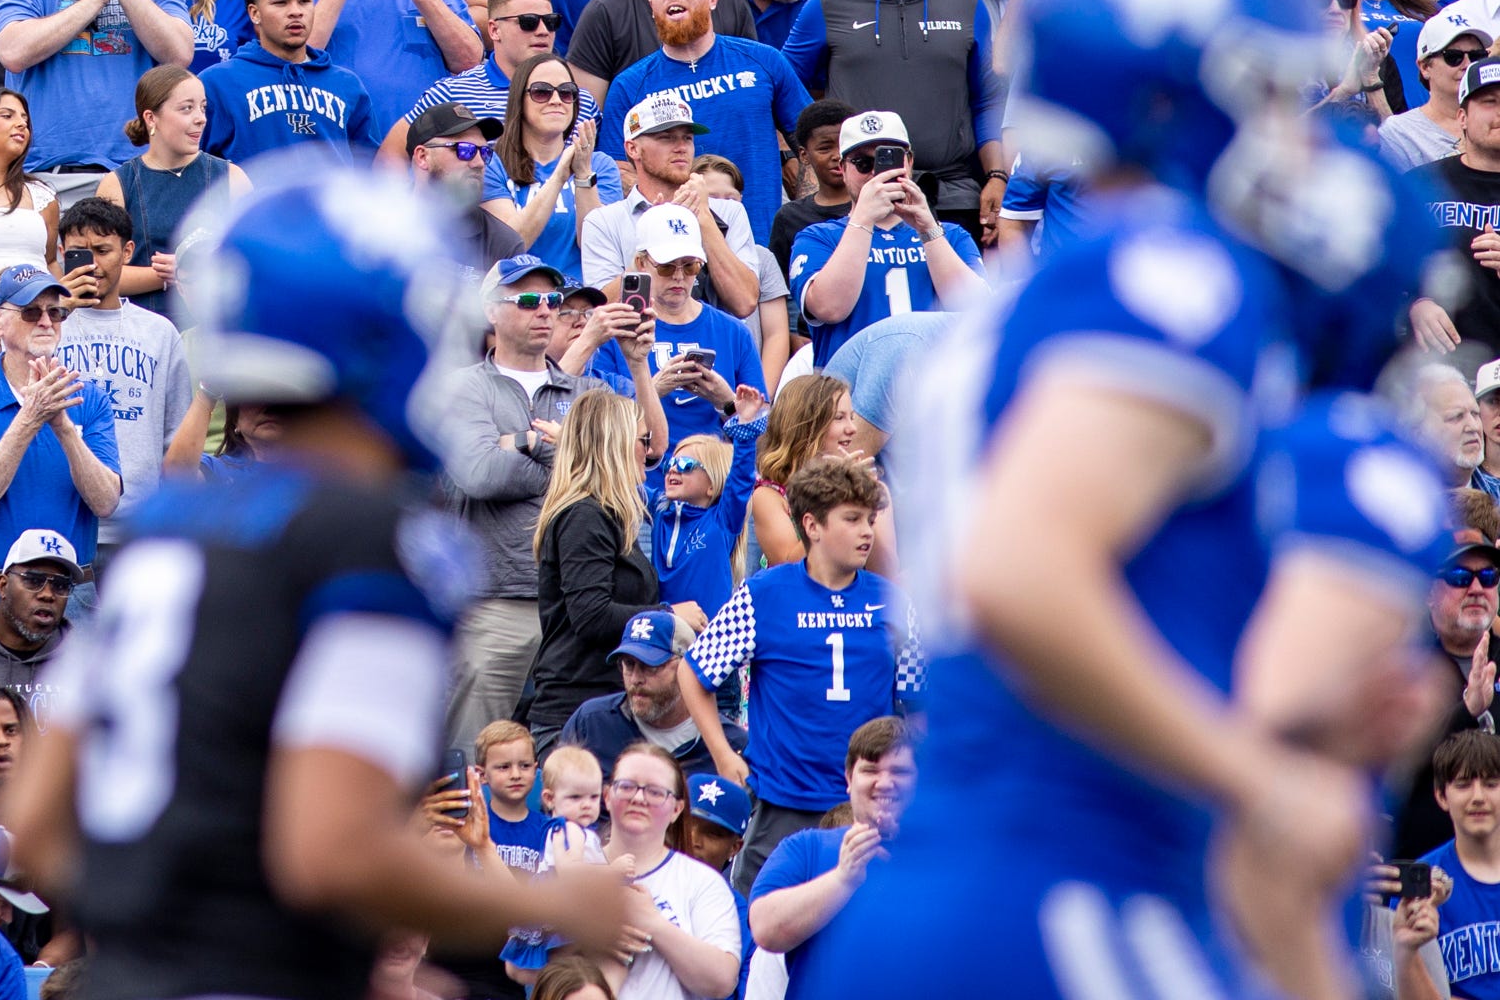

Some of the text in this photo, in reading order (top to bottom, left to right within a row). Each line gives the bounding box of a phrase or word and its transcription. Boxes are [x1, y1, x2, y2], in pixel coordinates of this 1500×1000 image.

[919, 20, 962, 32] WILDCATS
[1447, 14, 1472, 27] UK
[245, 83, 347, 130] KENTUCKY
[286, 112, 317, 135] UK
[667, 219, 689, 235] UK
[884, 267, 913, 317] 1
[54, 342, 158, 390] KENTUCKY
[128, 386, 142, 399] 65
[40, 535, 64, 556] UK
[831, 595, 845, 609] UK
[631, 617, 655, 641] UK
[797, 611, 873, 629] KENTUCKY
[825, 633, 851, 702] 1
